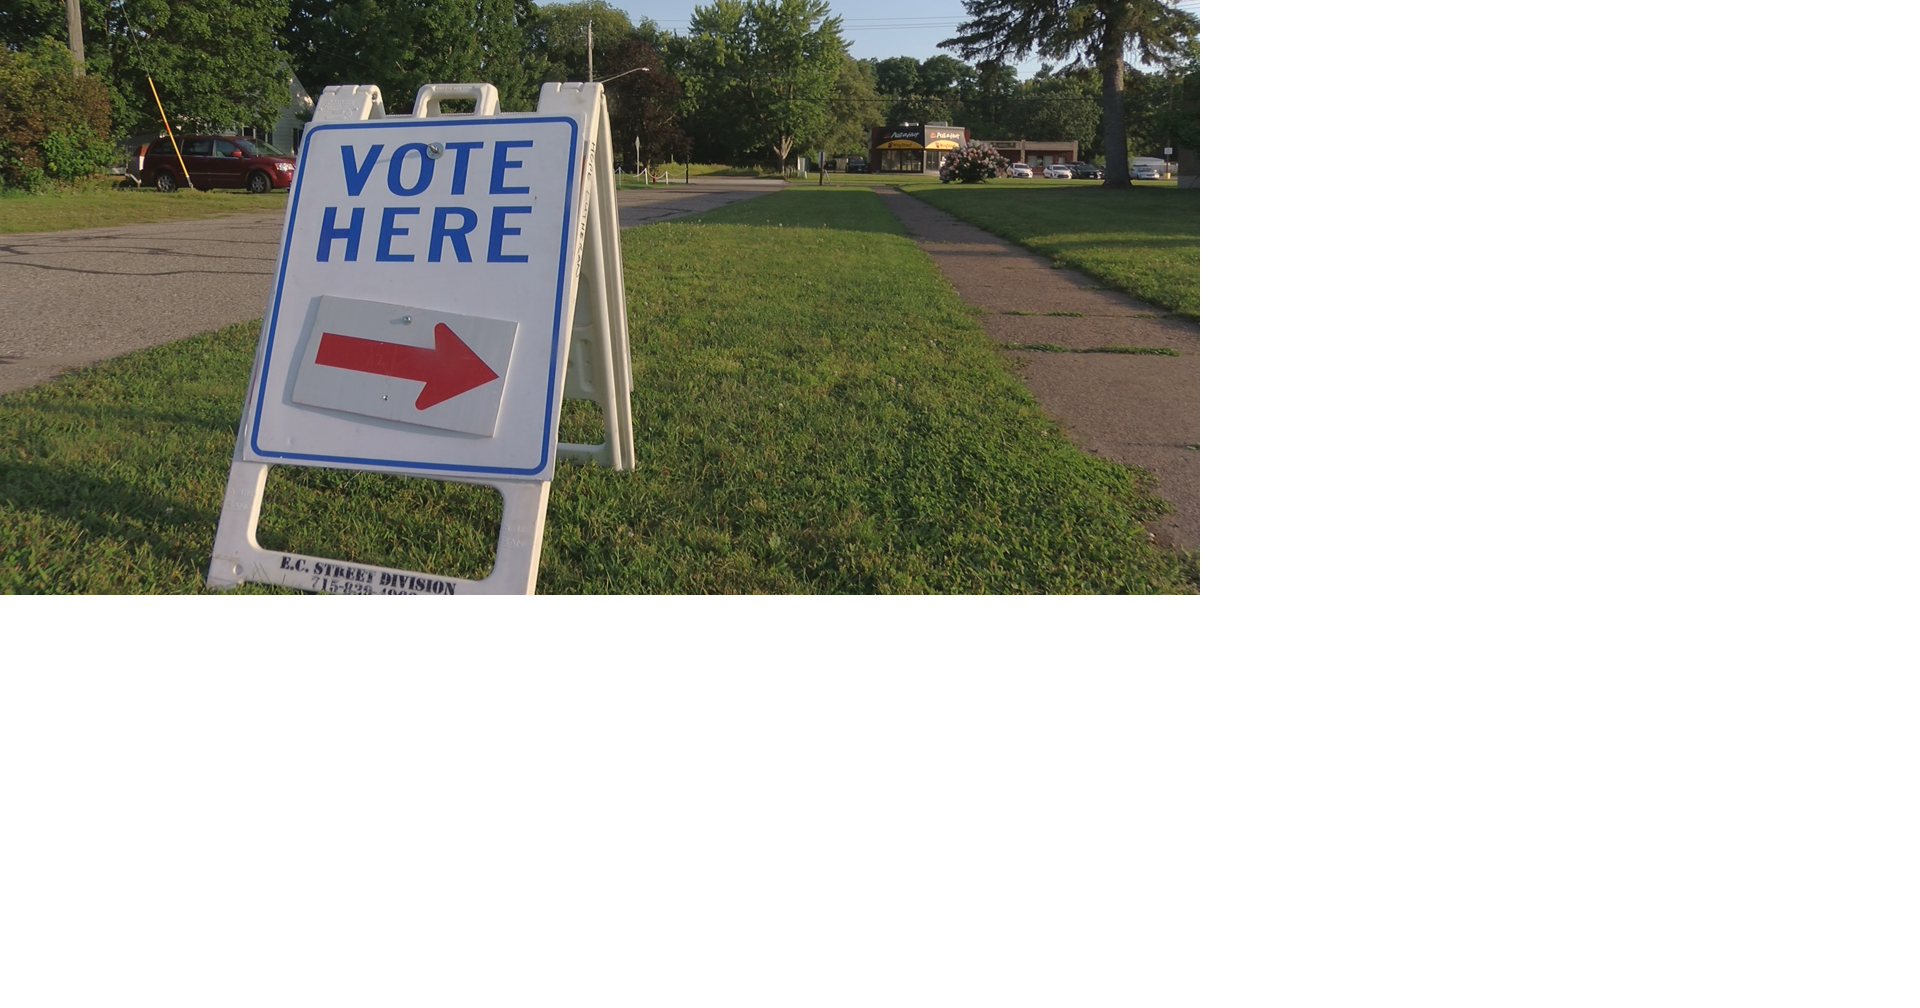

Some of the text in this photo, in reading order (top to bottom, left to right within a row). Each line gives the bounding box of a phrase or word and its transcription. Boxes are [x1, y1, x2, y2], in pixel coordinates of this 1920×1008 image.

[340, 140, 534, 197] VOTE
[315, 206, 533, 263] HERE
[280, 555, 458, 595] E.C. STREET DIVISION
